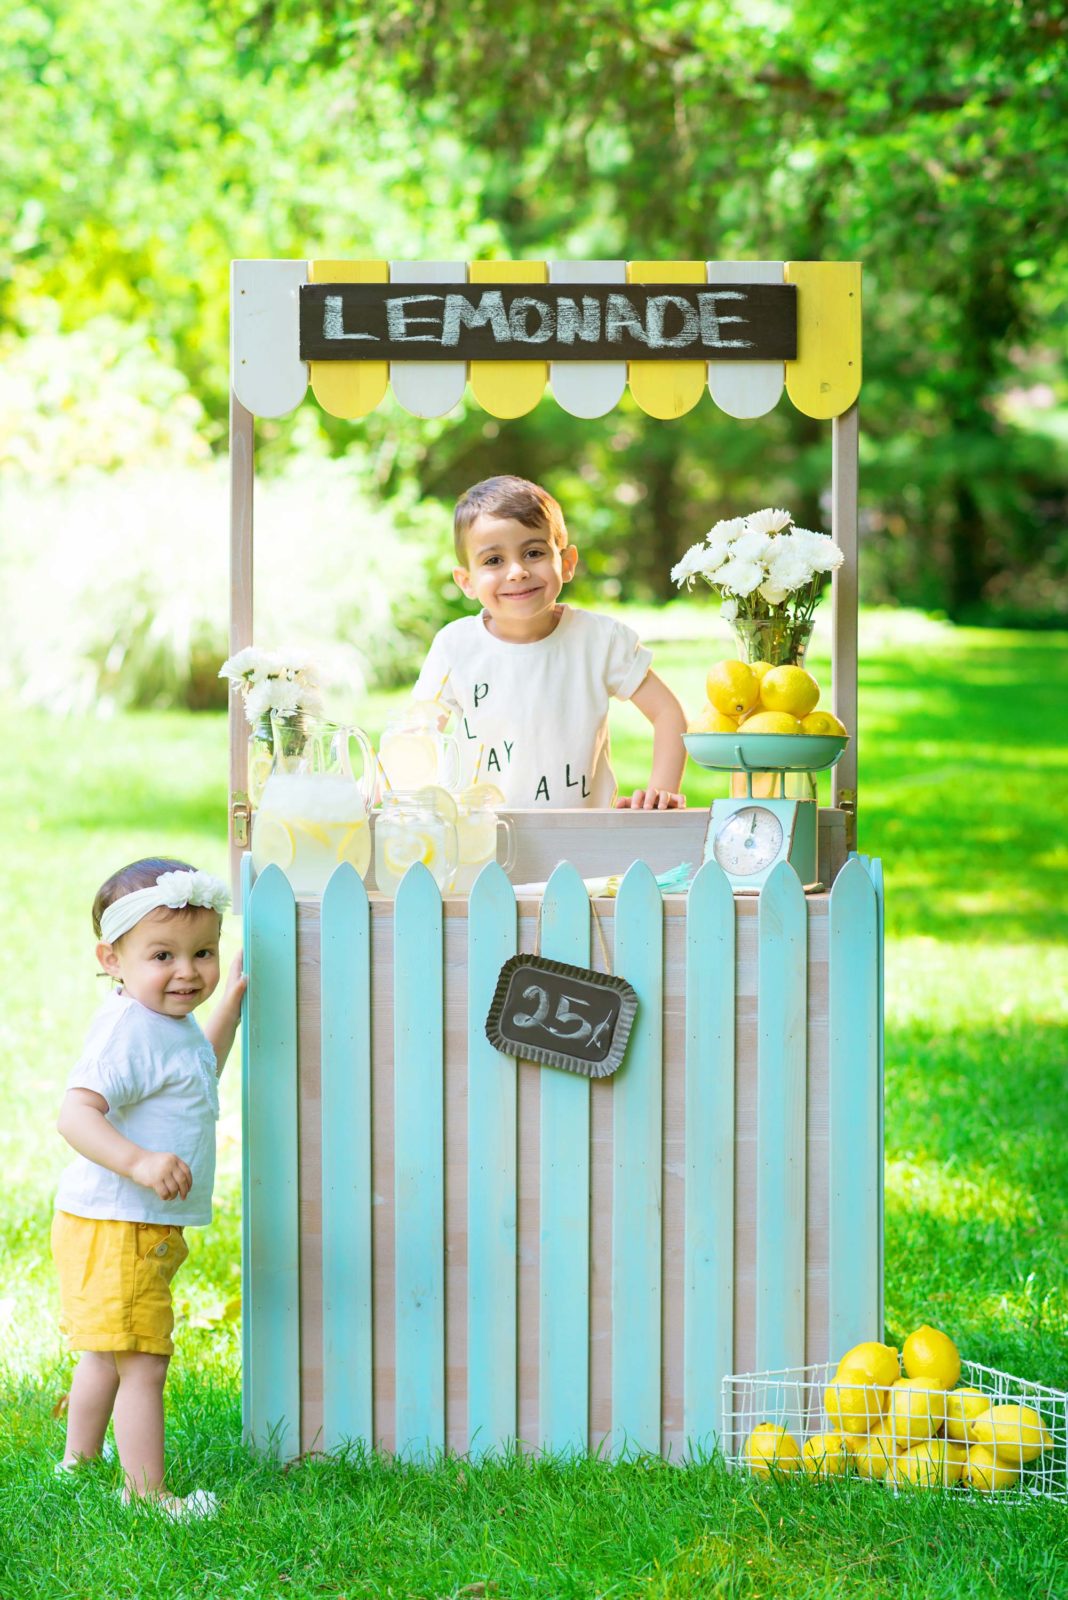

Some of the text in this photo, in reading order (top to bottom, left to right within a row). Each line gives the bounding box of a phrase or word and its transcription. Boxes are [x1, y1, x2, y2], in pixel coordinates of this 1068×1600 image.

[322, 290, 755, 349] LEMONADE
[535, 764, 591, 801] ALL
[512, 985, 613, 1049] 25¢
